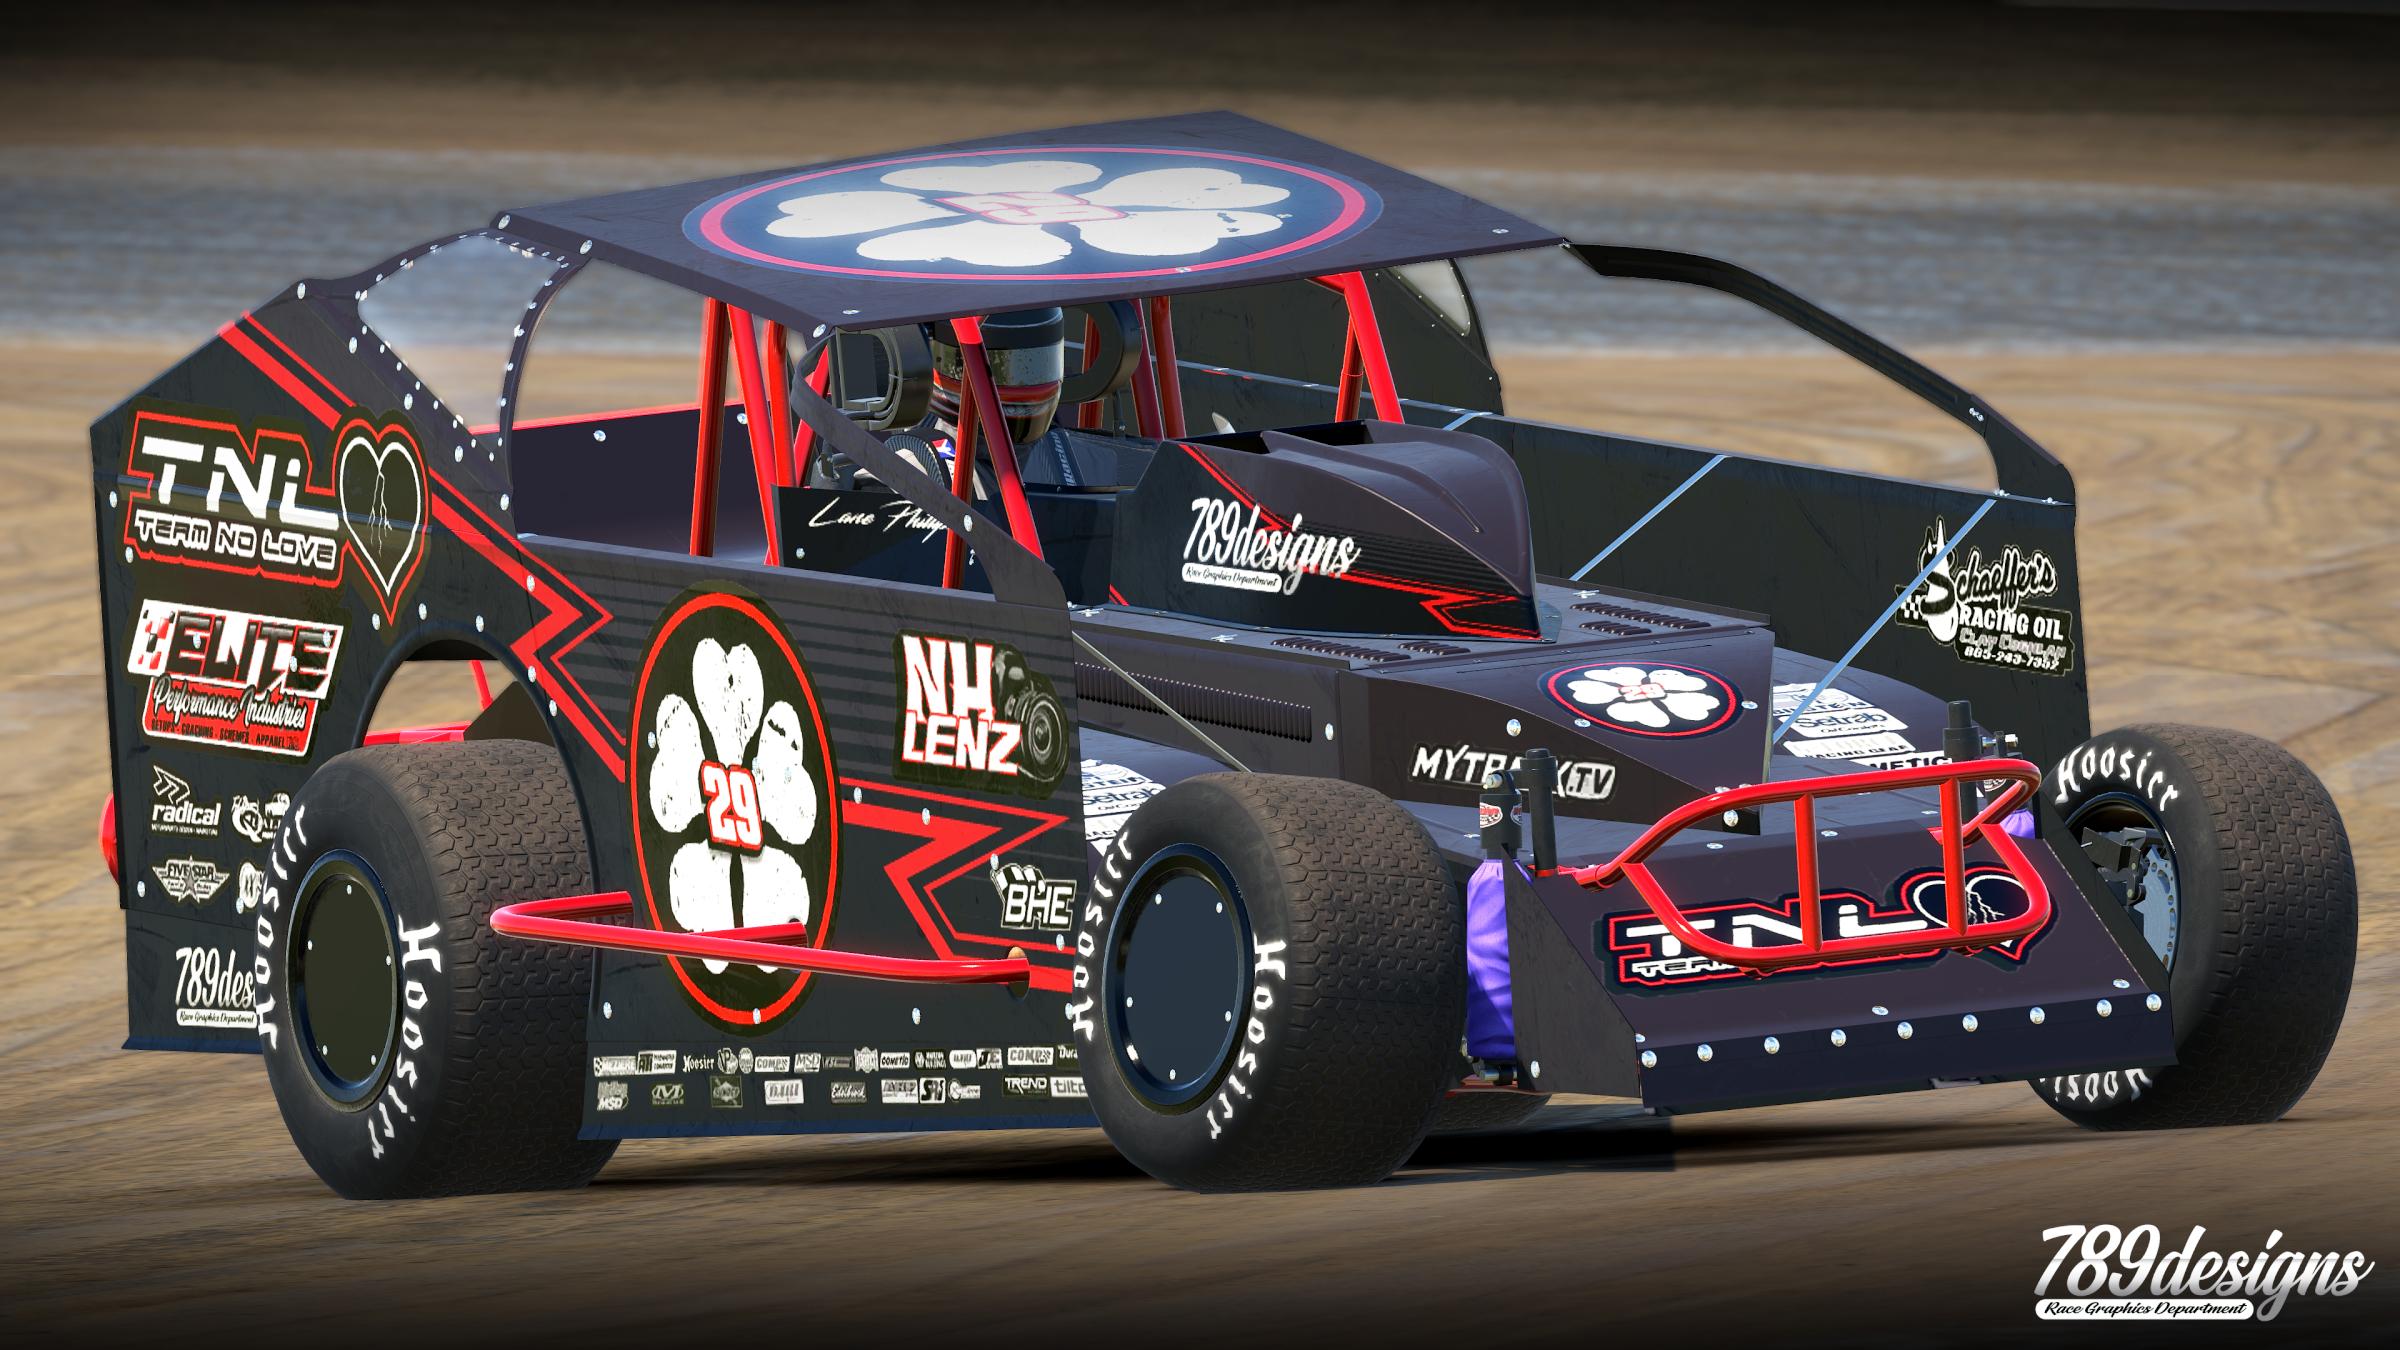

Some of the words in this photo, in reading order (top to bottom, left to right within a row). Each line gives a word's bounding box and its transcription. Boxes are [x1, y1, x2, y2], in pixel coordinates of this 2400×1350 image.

[141, 436, 339, 531] TNL
[134, 509, 211, 551] TEAM
[214, 521, 257, 558] NO
[261, 530, 337, 571] LOVE
[1182, 497, 1361, 596] 789designs
[165, 610, 333, 693] ELITE
[1959, 604, 2030, 635] RACING
[2033, 616, 2064, 641] OIL
[154, 676, 239, 724] Performance
[240, 687, 308, 729] Industries
[901, 635, 996, 722] NH
[902, 709, 1023, 777] LENZ
[1795, 710, 1888, 728] Setrab
[703, 764, 763, 848] 29
[1411, 744, 1616, 800] MYTRK.TV
[2055, 744, 2180, 812] Hoosier
[152, 800, 222, 826] radical
[253, 805, 308, 1051] Hoosier
[1003, 881, 1076, 930] BHE
[1072, 831, 1133, 1043] Hoosier
[175, 946, 257, 1009] 789des
[369, 915, 442, 1159] Hoosier
[682, 1054, 715, 1073] Hoosier
[1206, 933, 1287, 1140] Hoosier
[1004, 1077, 1048, 1095] TREND
